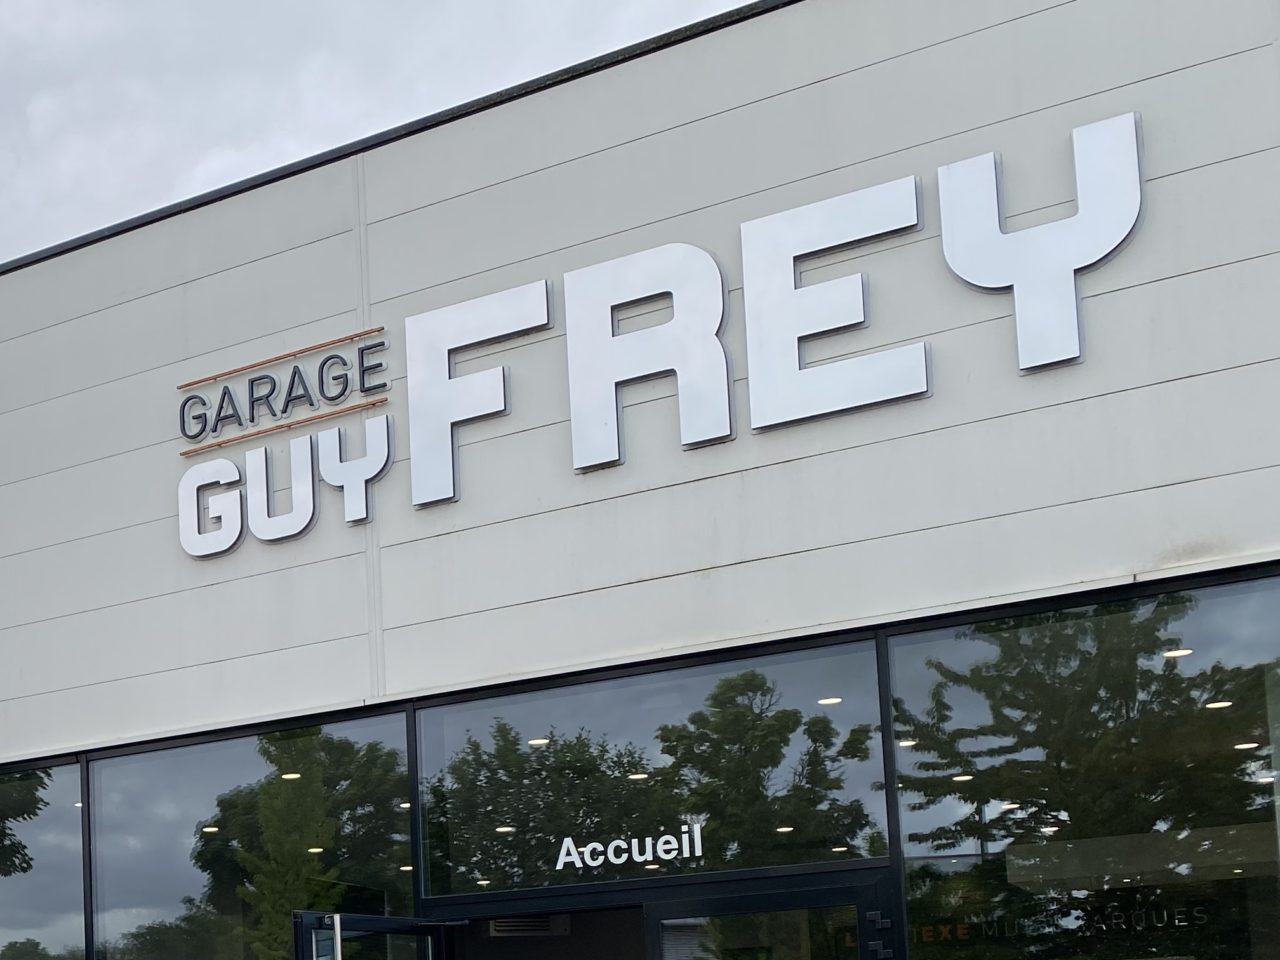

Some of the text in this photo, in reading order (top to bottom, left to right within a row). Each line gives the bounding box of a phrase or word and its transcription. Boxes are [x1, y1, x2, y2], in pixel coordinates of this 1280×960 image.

[178, 111, 1142, 558] GUY FREY
[179, 340, 389, 440] GARAGE
[555, 823, 703, 871] Accueil
